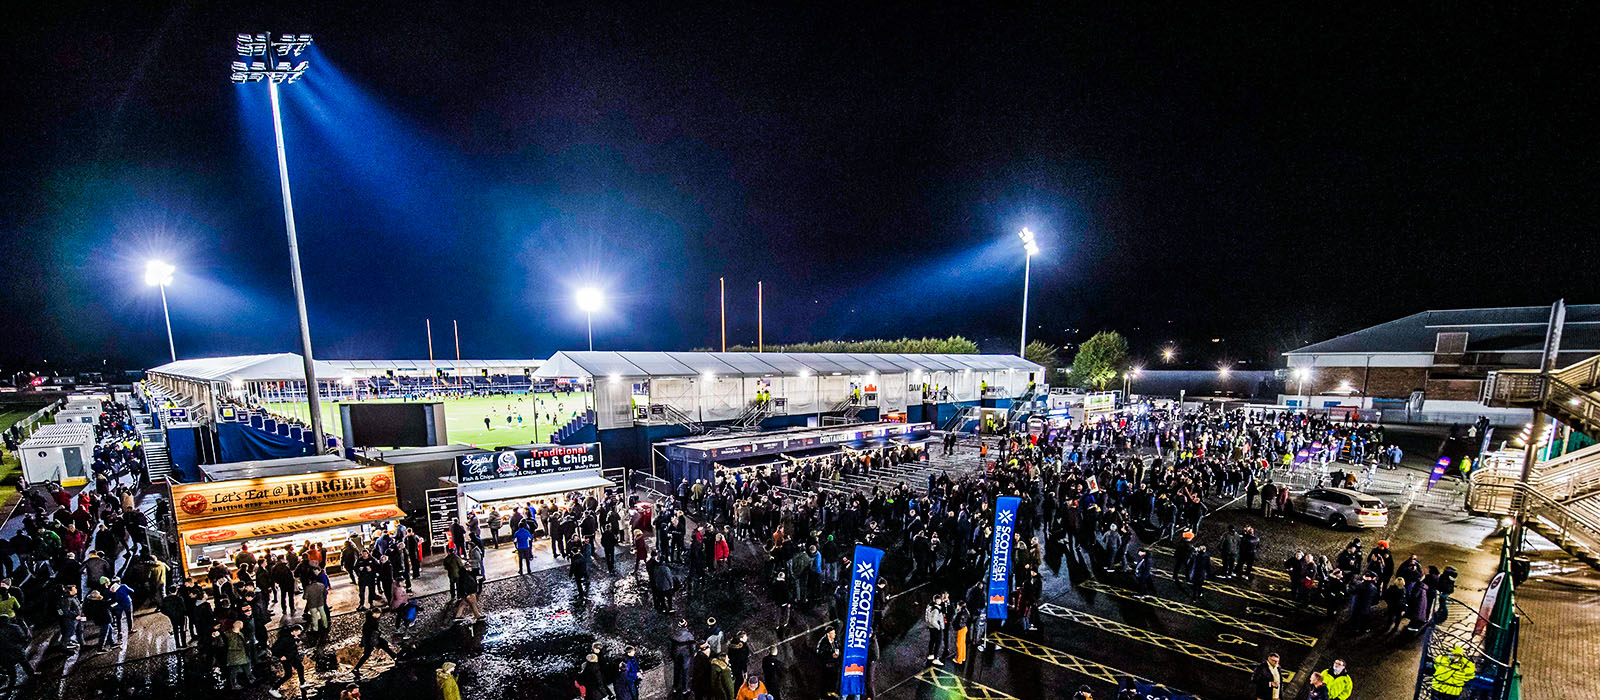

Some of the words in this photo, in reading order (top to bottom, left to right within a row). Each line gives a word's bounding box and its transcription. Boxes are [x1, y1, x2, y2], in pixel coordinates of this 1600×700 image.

[523, 457, 549, 469] Fish
[551, 455, 561, 465] &
[563, 453, 594, 465] Chips
[531, 445, 587, 458] Traditional
[211, 491, 242, 505] Let's
[244, 488, 270, 501] Eat
[272, 485, 284, 497] @
[286, 477, 367, 497] BURGER
[993, 525, 1002, 555] BUILDING
[999, 526, 1011, 581] SCOTTISH
[851, 580, 861, 615] BUILDING
[854, 582, 873, 649] SCOTTISH
[848, 616, 857, 649] SOCIETY
